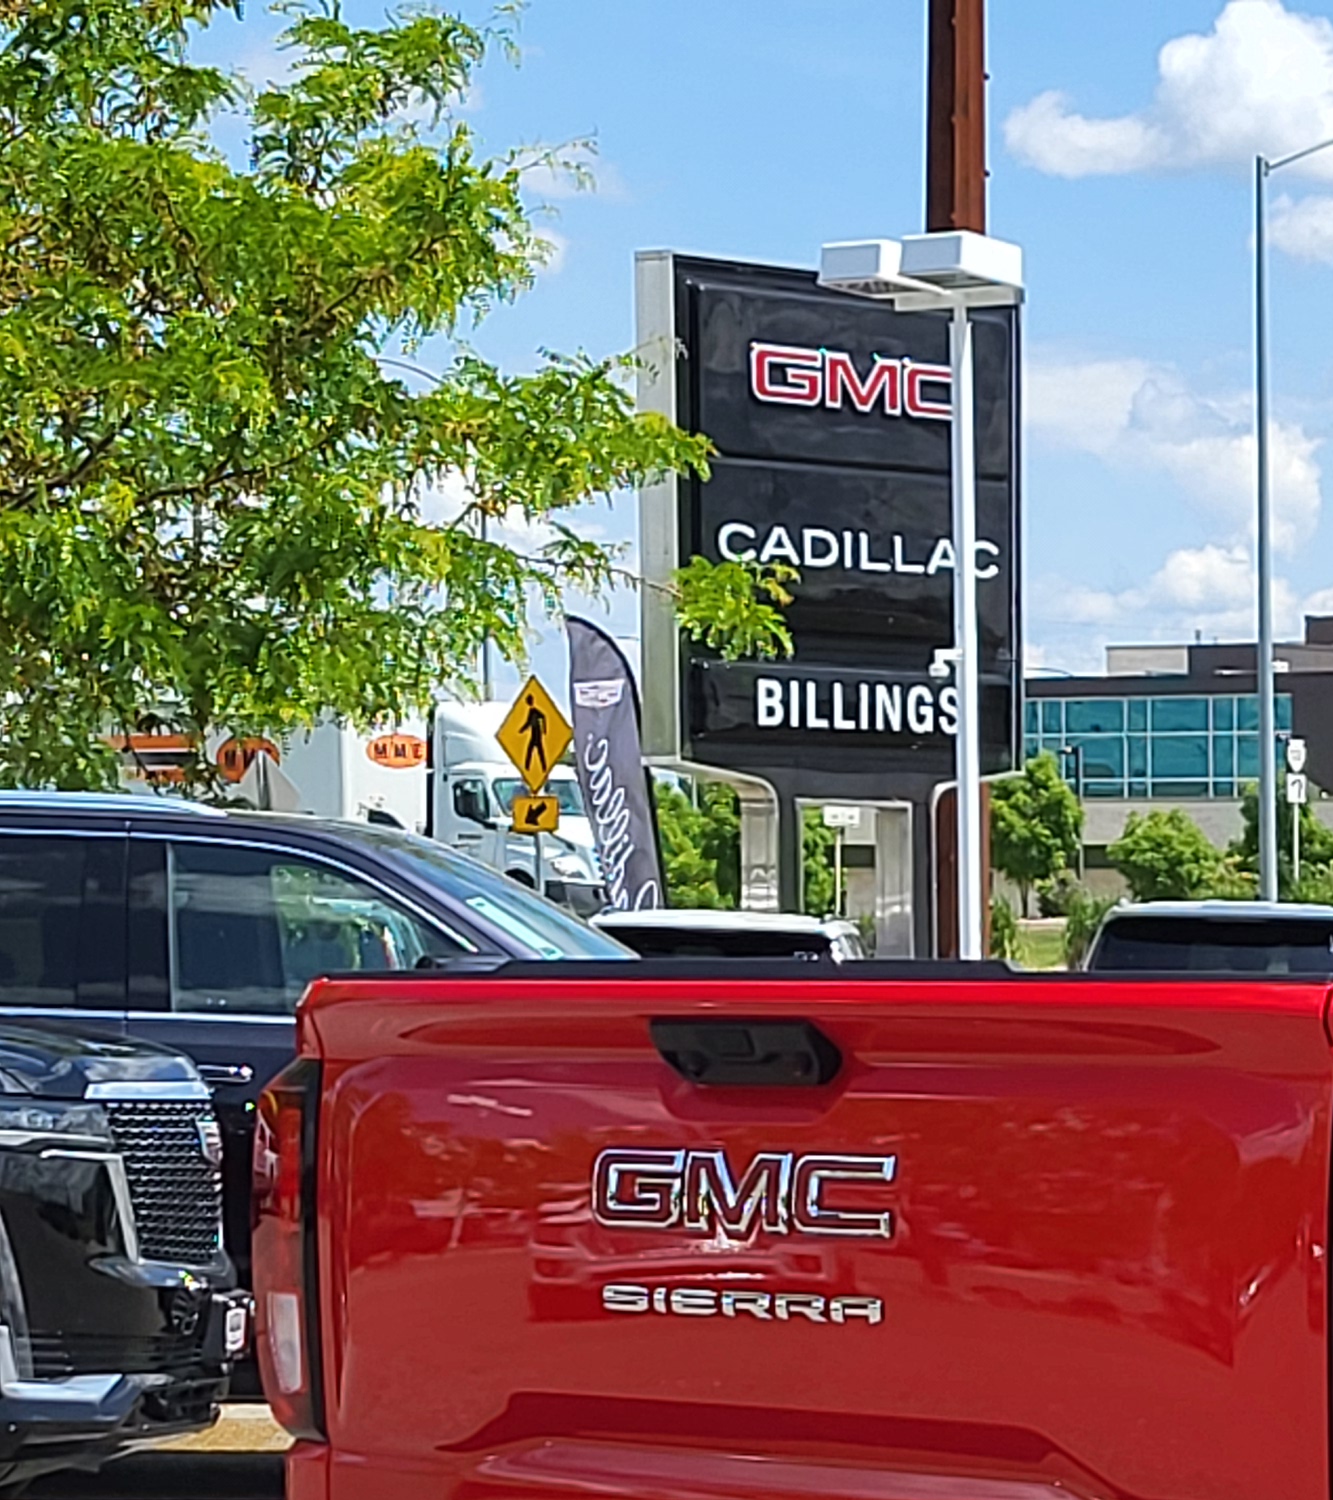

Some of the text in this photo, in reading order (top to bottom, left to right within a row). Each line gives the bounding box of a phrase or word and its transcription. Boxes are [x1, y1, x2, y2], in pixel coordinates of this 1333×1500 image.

[750, 341, 952, 420] GMC
[717, 522, 999, 579] CADILLAC
[757, 677, 958, 735] BILLINGS
[591, 1148, 896, 1240] GMC
[602, 1284, 883, 1325] SIERRA
